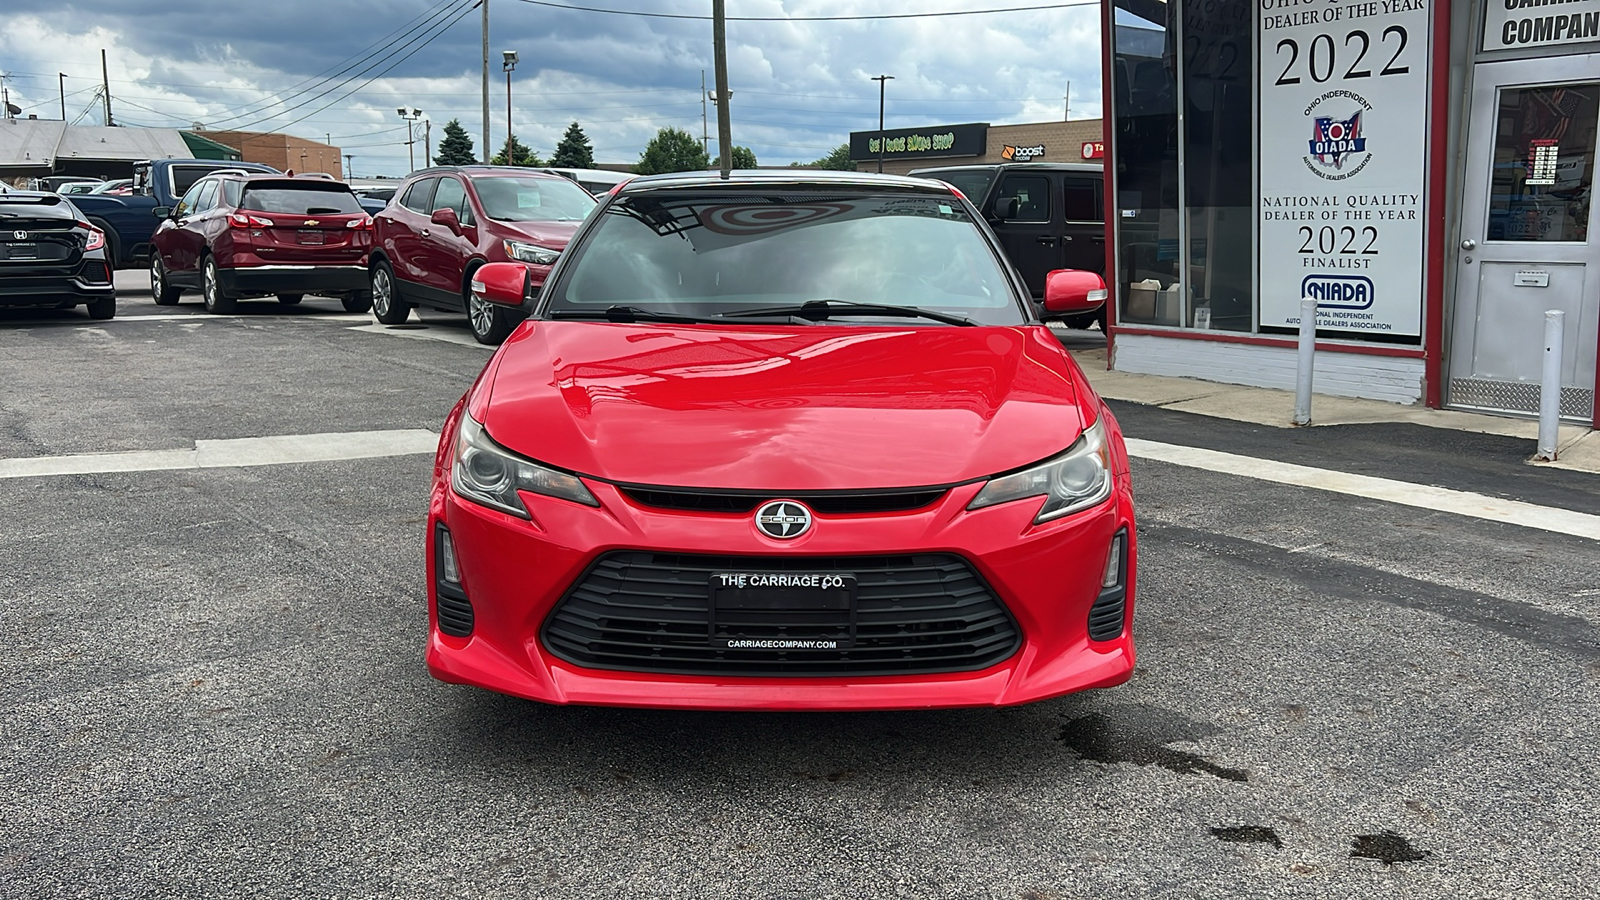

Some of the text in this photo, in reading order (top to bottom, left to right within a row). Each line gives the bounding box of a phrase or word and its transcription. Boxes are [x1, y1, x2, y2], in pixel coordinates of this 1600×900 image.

[1264, 11, 1319, 30] DEALER
[1323, 7, 1343, 22] OF
[1346, 3, 1377, 20] THE
[1381, 0, 1424, 14] YEAR
[1275, 25, 1409, 86] 2022
[1304, 90, 1373, 116] OHIO INDEPENDENT
[1015, 145, 1044, 156] boost
[1316, 140, 1356, 153] OIADA
[1303, 156, 1326, 178] AUTOMOBILE
[1347, 152, 1373, 177] ASSOCIATION
[1263, 195, 1419, 208] NATIONAL QUALITY
[1264, 210, 1416, 220] DEALER OF THE YEAR
[1298, 226, 1378, 254] 2022
[1303, 258, 1371, 268] FINALIST
[1307, 282, 1366, 302] NIADA
[1350, 322, 1392, 330] ASSOCIATION
[720, 574, 845, 588] THE CARRIAGE CO.
[728, 640, 837, 649] CARRIAGECOMPANY.COM
